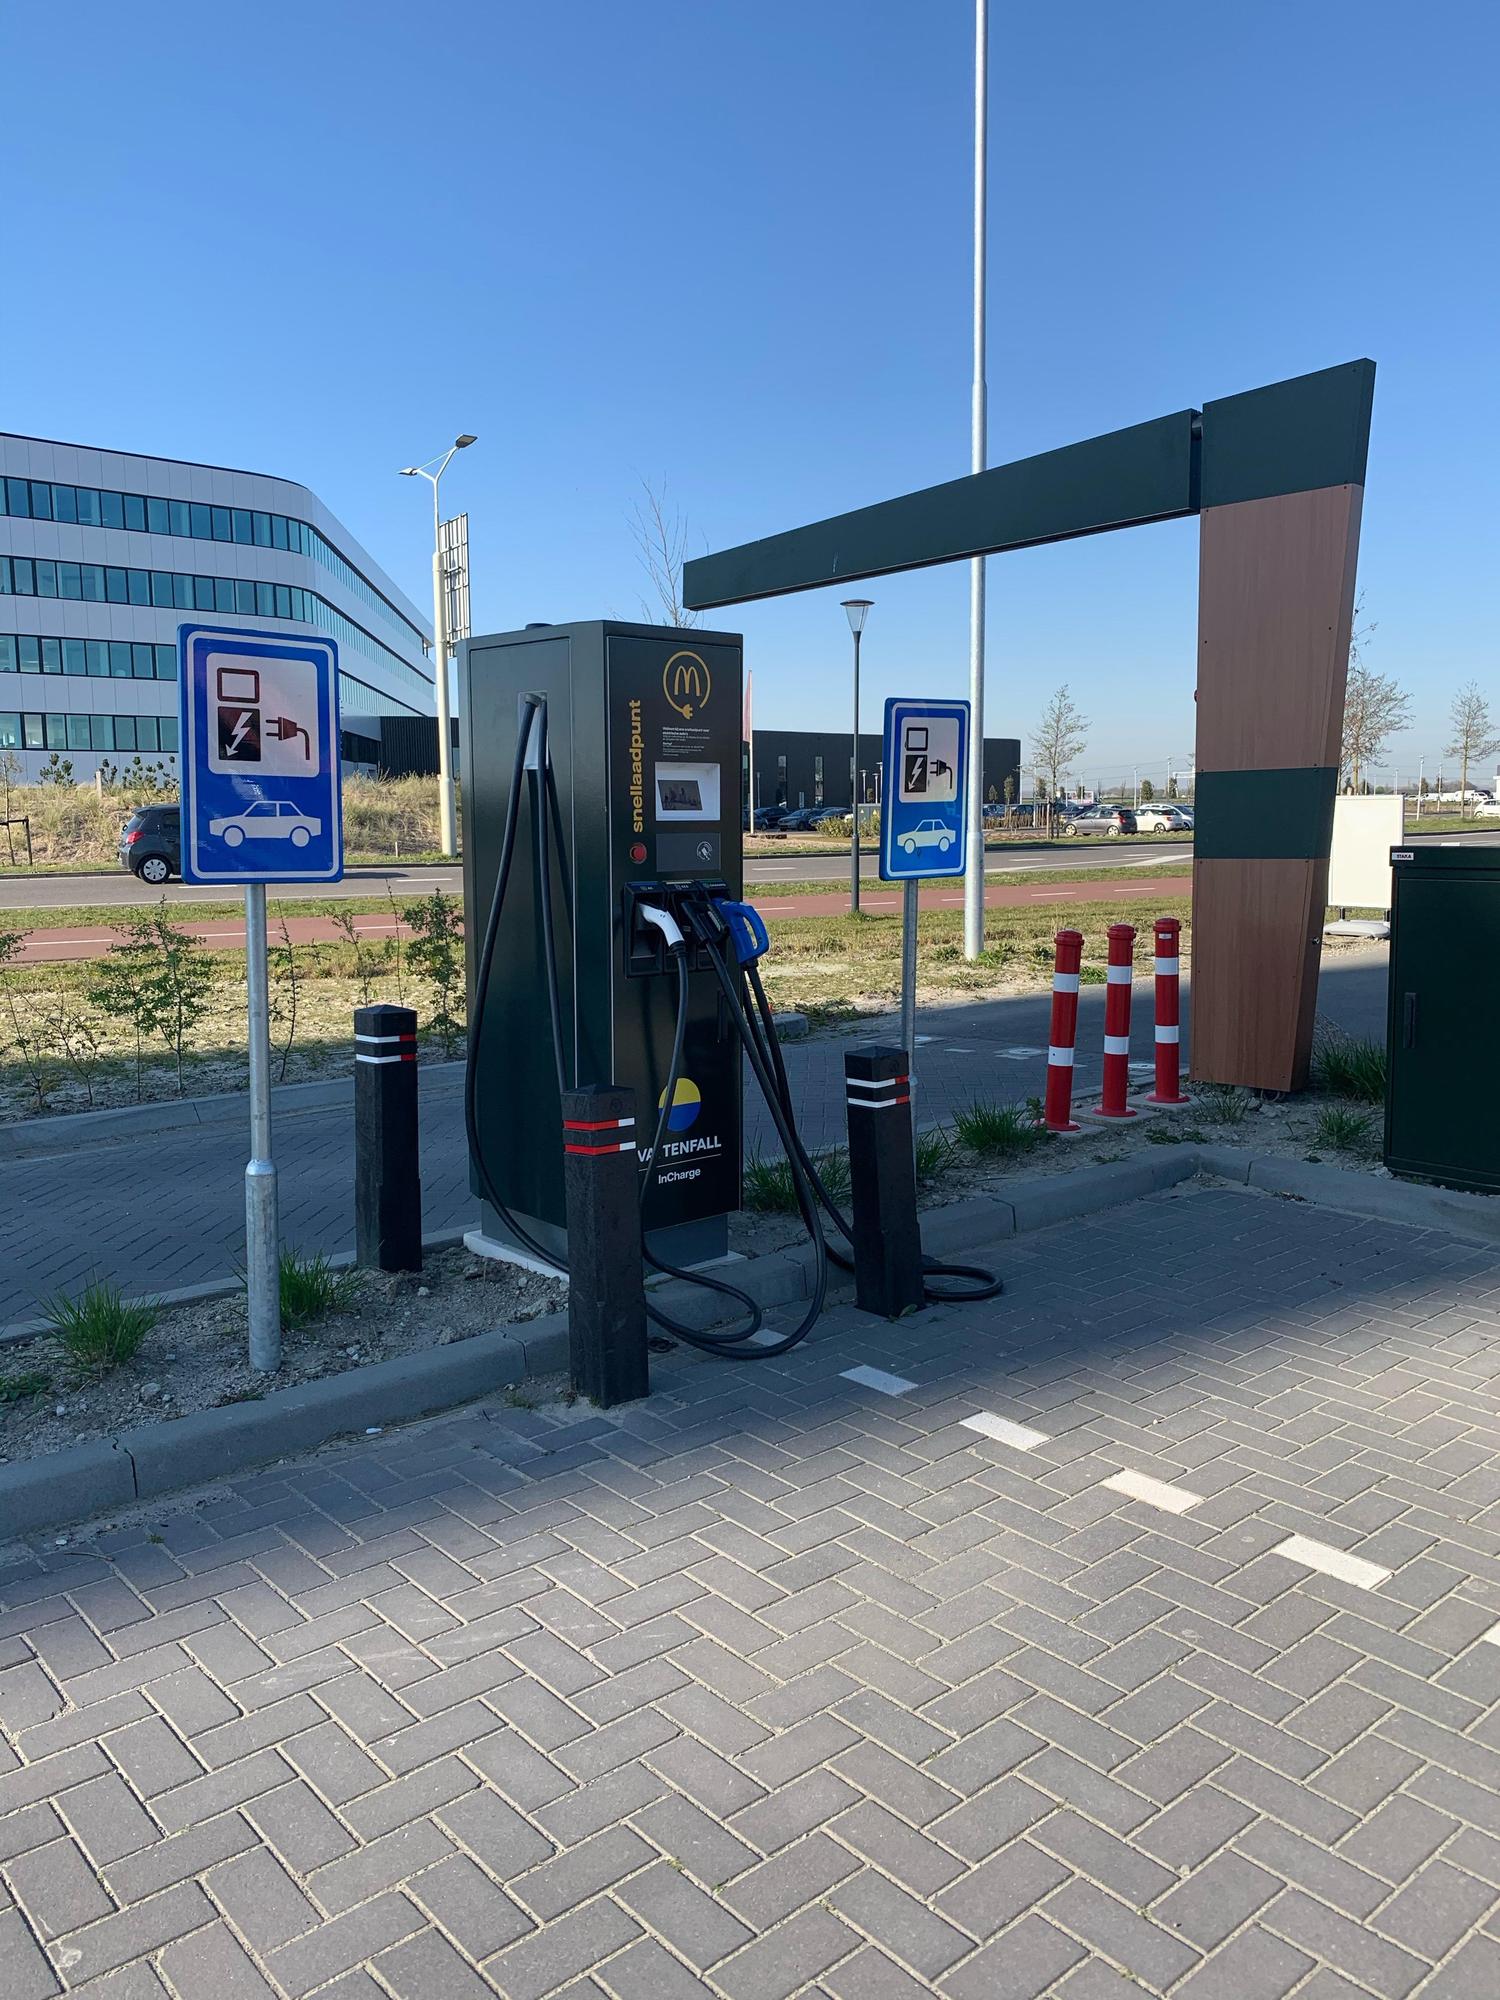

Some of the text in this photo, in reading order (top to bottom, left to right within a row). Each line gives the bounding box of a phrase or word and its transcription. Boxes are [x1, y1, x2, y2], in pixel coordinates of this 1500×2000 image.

[629, 700, 645, 833] snellaadpunt
[637, 1135, 722, 1162] VATENFALL
[658, 1168, 701, 1184] InCharge
